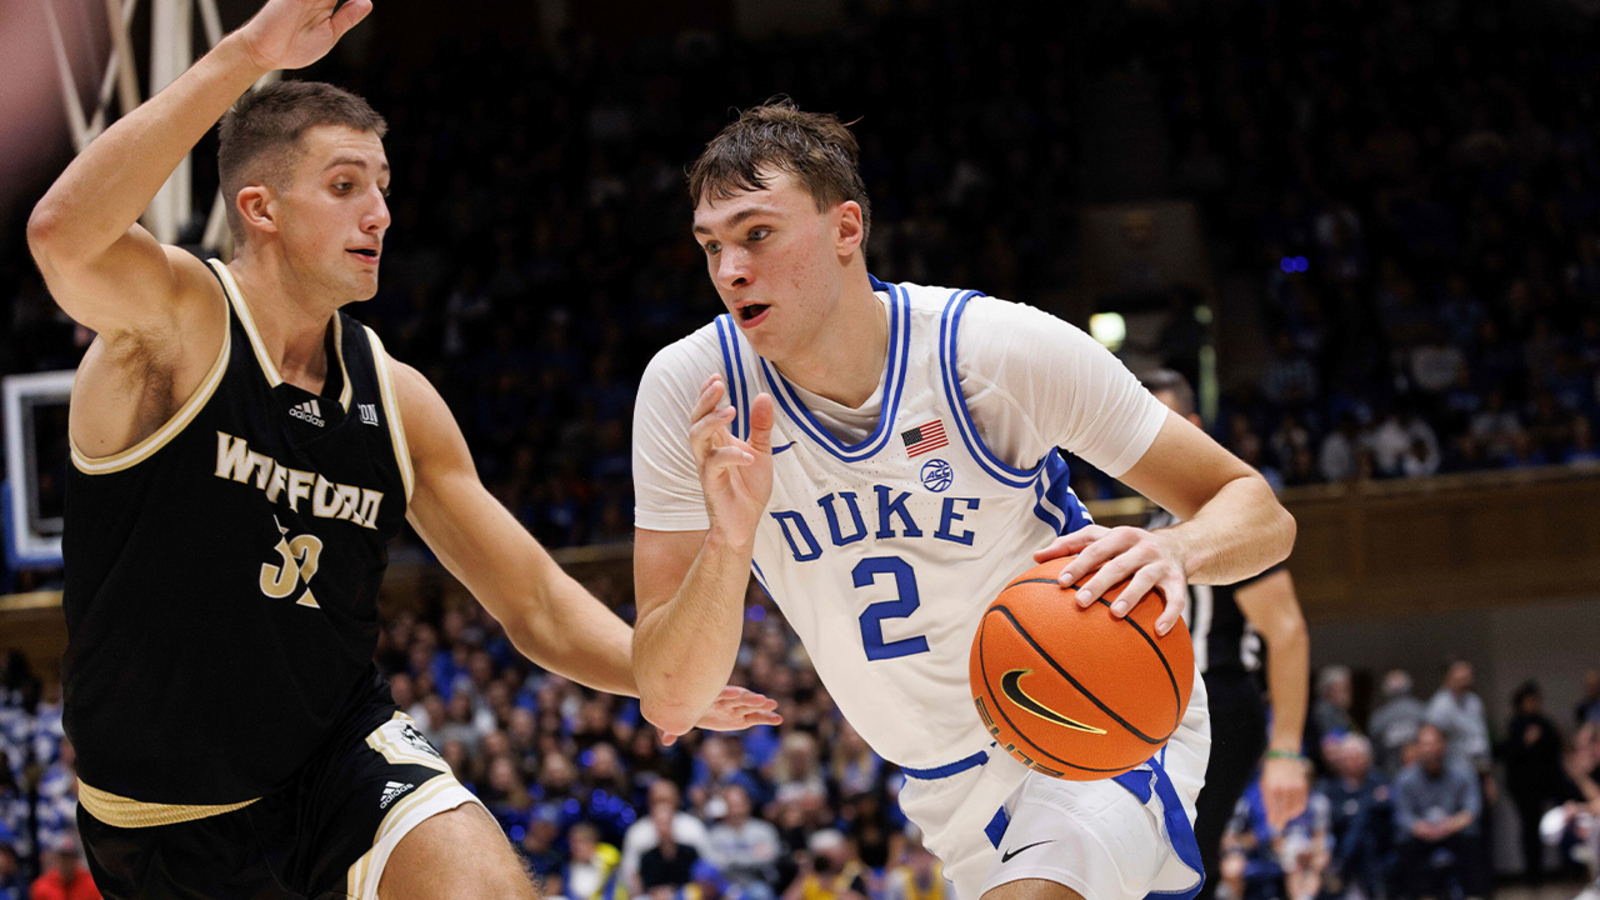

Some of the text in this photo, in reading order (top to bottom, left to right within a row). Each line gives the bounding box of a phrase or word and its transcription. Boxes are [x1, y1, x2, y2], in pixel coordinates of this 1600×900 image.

[289, 407, 325, 428] adidas
[925, 465, 951, 481] ACC
[769, 484, 981, 562] DUKE
[851, 556, 931, 661] 2
[379, 783, 415, 809] adidas
